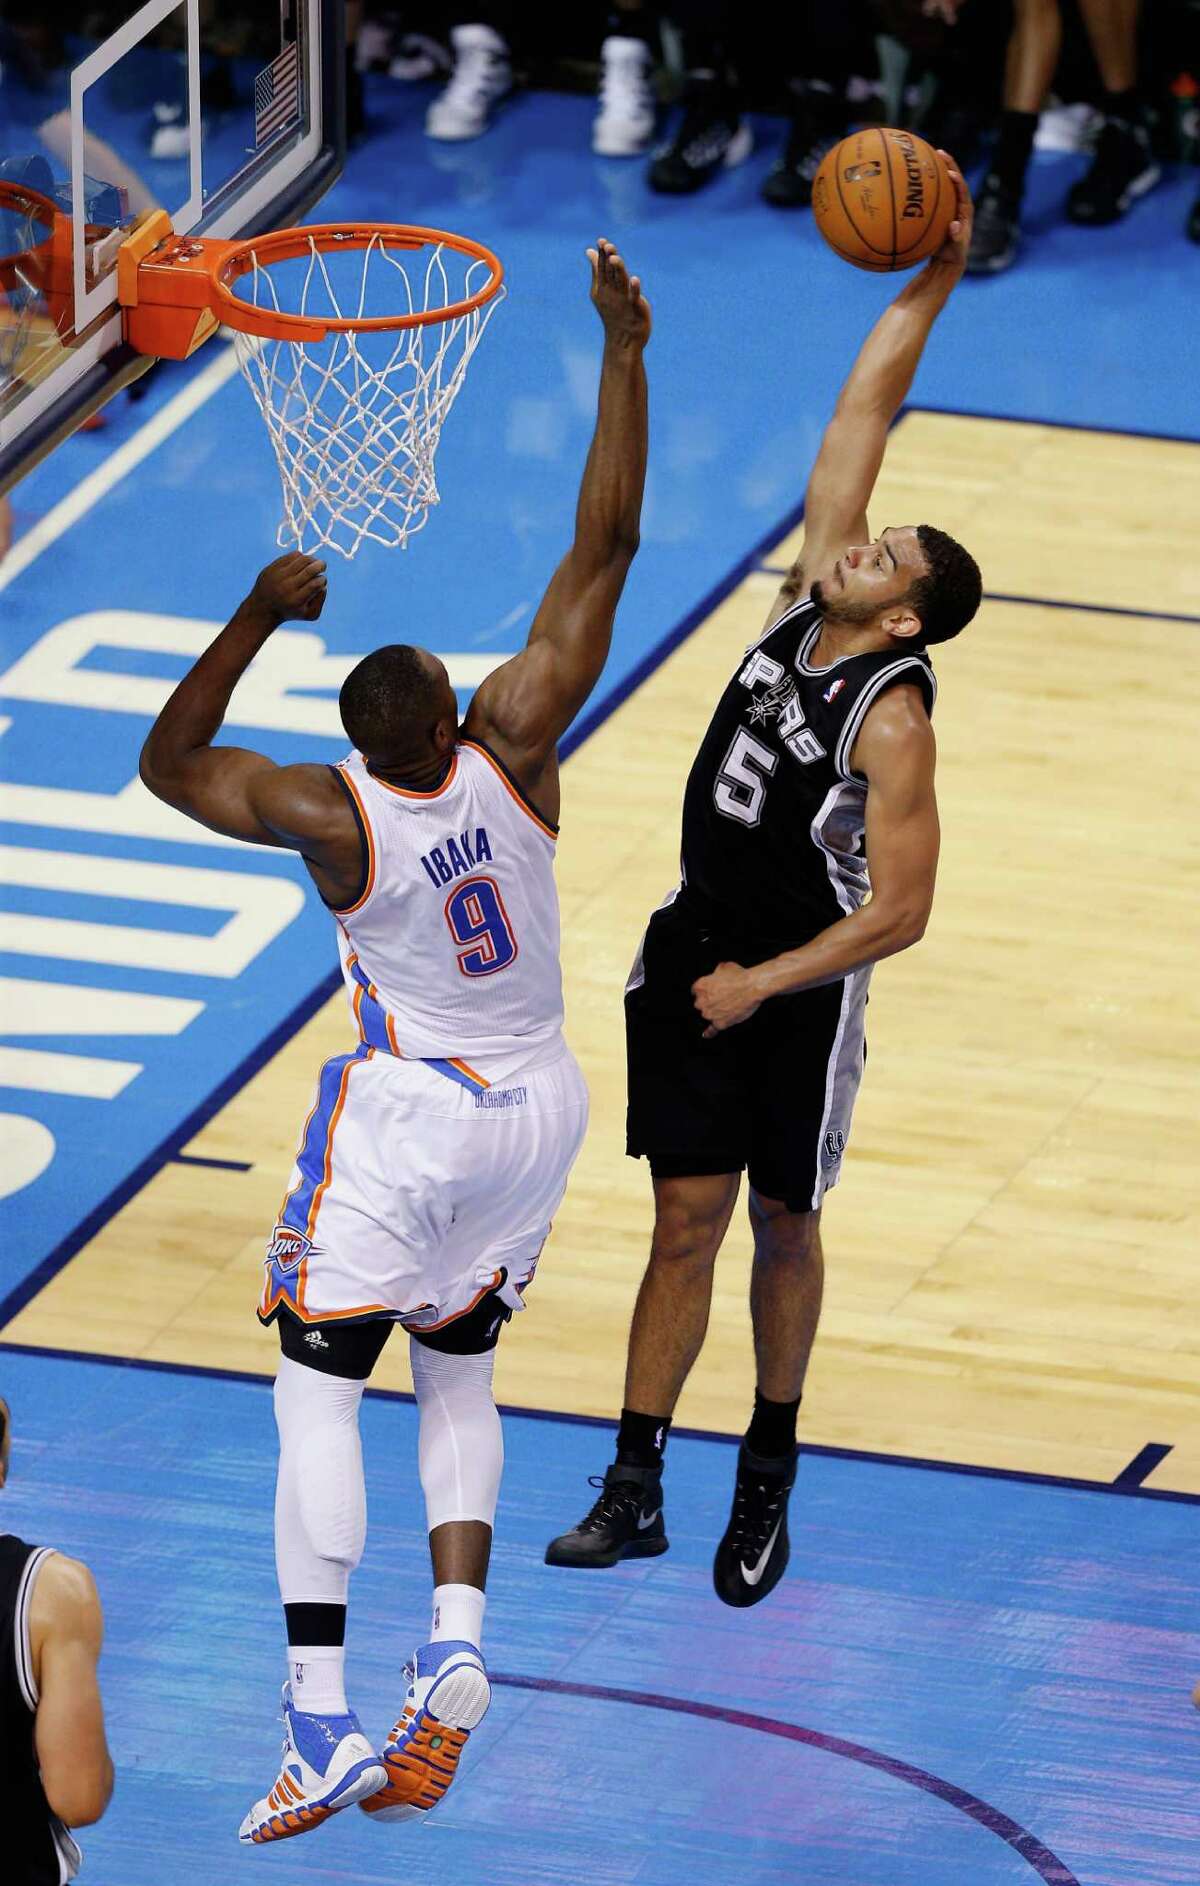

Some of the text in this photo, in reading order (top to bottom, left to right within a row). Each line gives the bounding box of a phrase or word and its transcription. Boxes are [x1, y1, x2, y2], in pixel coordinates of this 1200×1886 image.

[713, 724, 780, 829] 5
[420, 828, 493, 889] IBAKA
[444, 875, 518, 977] 9
